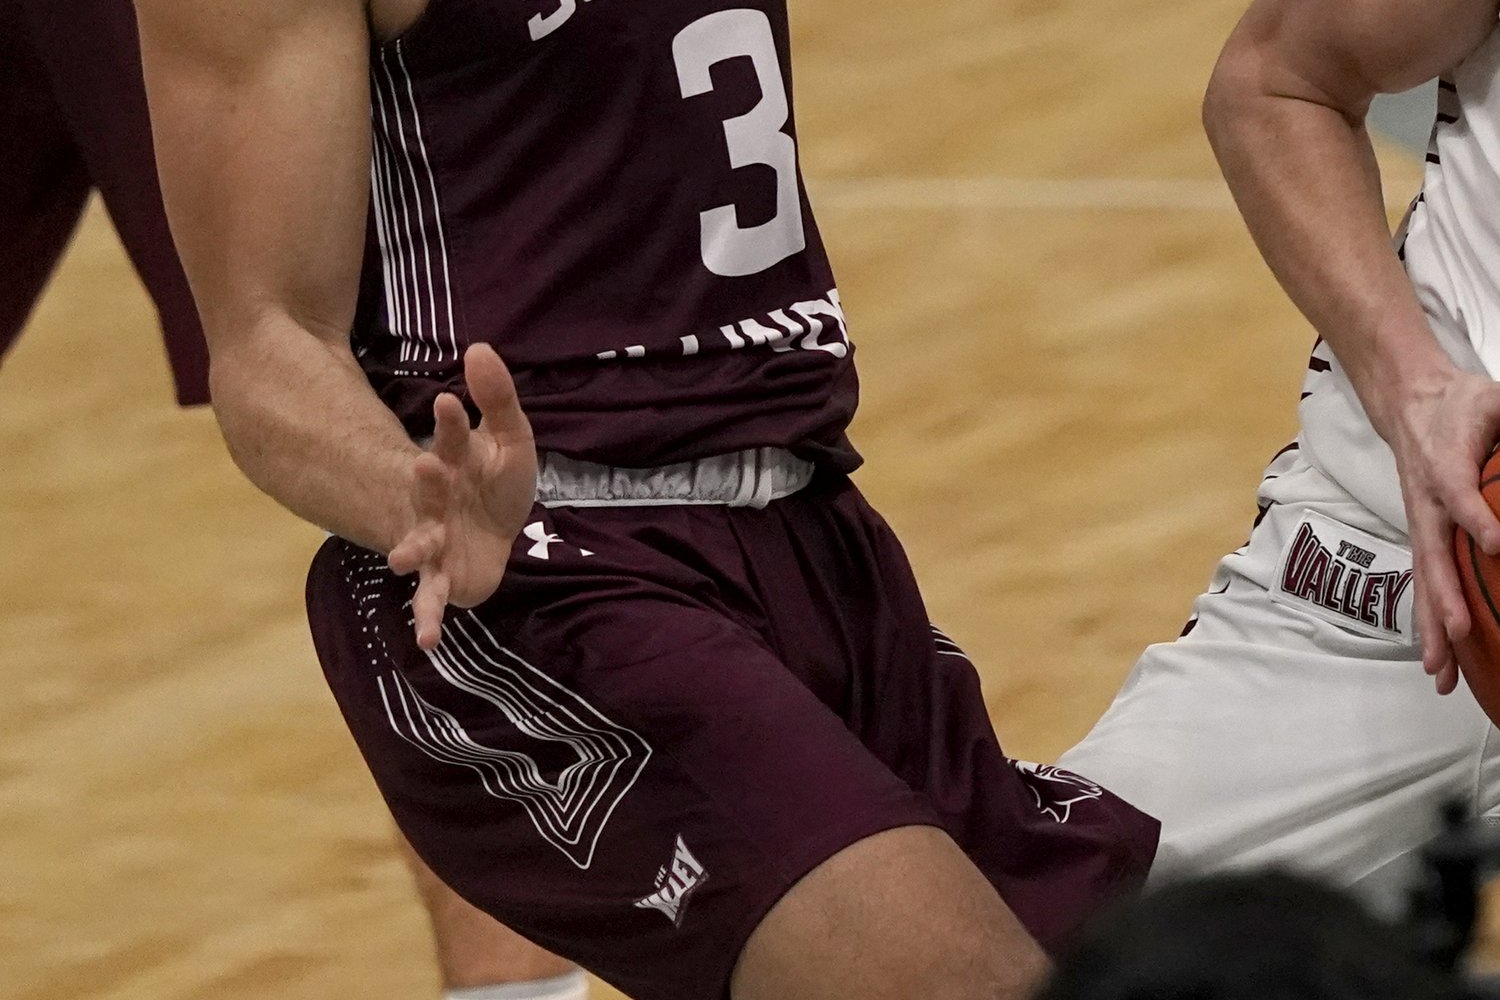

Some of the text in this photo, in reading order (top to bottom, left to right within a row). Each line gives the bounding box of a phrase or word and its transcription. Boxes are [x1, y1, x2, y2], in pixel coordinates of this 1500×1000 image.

[672, 8, 806, 277] 3
[1281, 522, 1413, 633] VALLEY
[1336, 539, 1377, 569] THE
